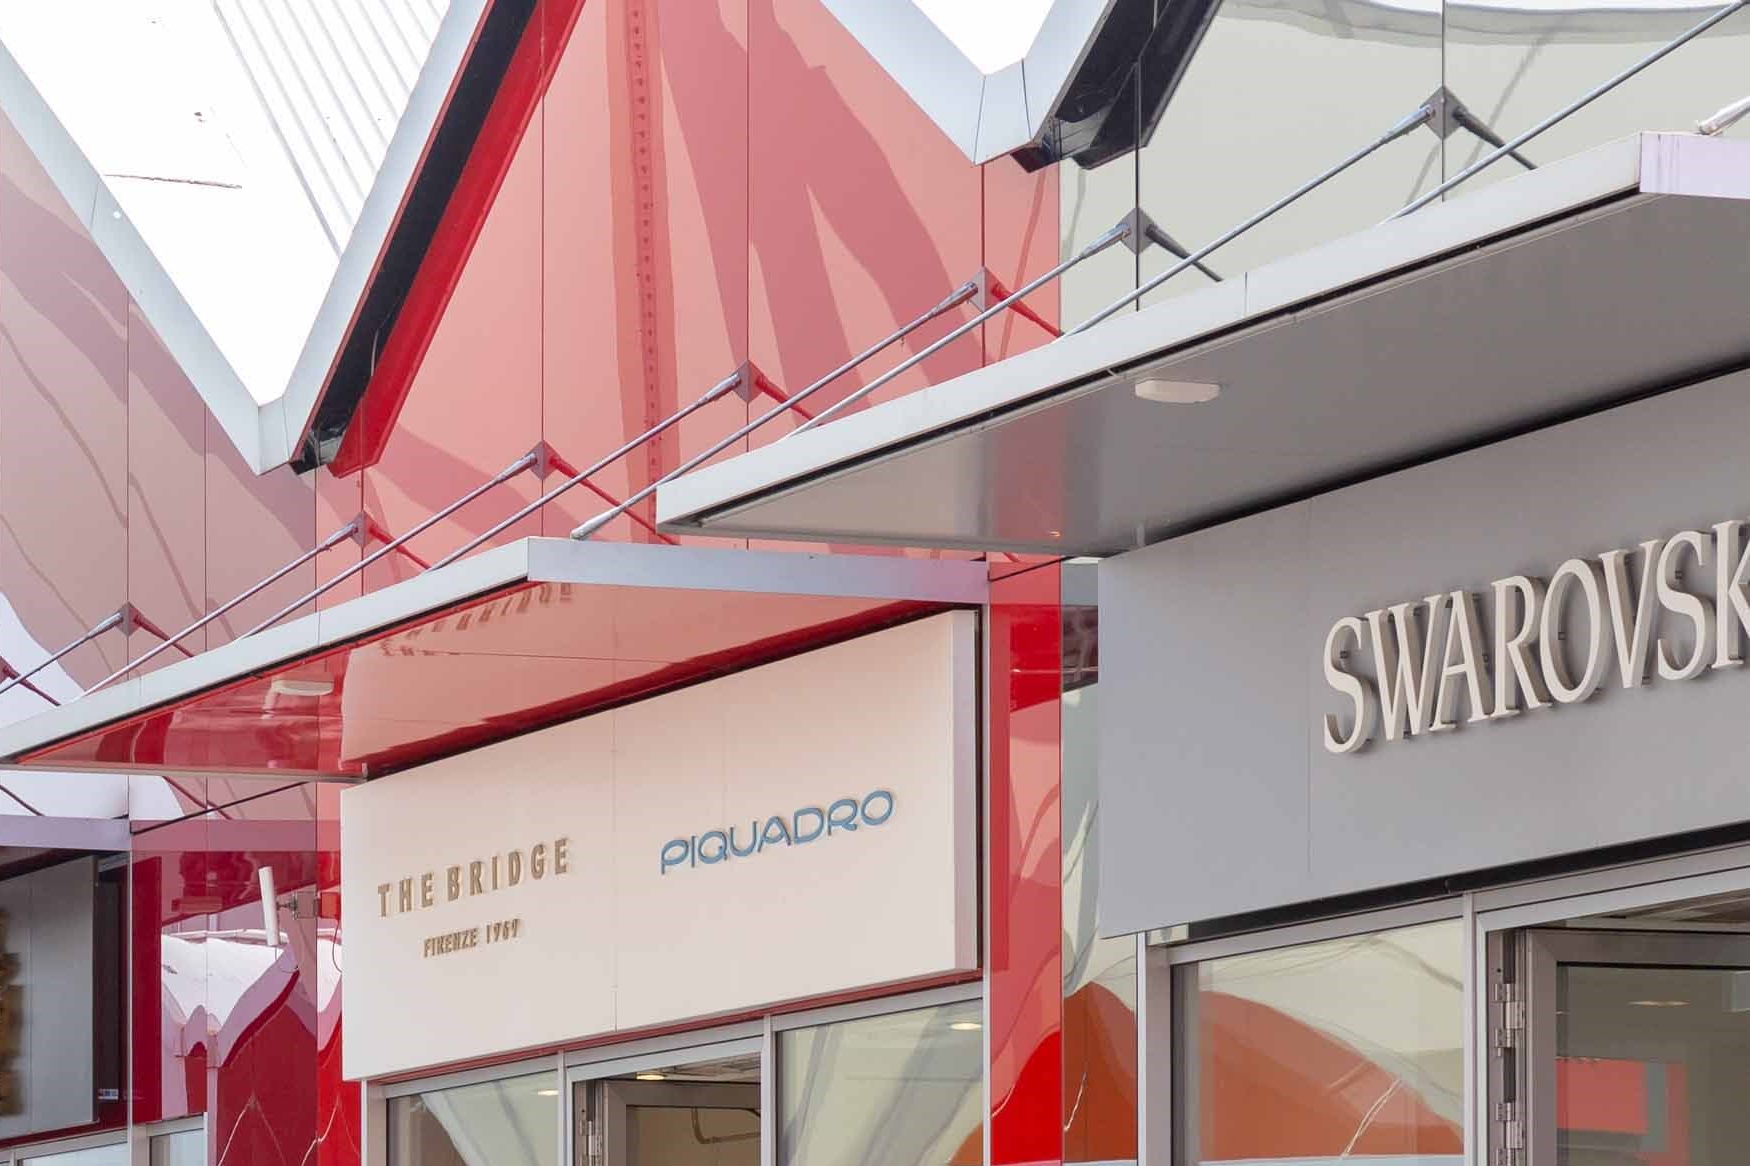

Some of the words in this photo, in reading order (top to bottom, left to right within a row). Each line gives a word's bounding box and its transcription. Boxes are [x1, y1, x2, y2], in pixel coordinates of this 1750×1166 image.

[660, 790, 896, 876] PIQUADRO
[377, 872, 434, 917] THE
[446, 838, 569, 902] BRIDGE
[423, 927, 479, 958] FIRENZE
[485, 918, 520, 944] 1969
